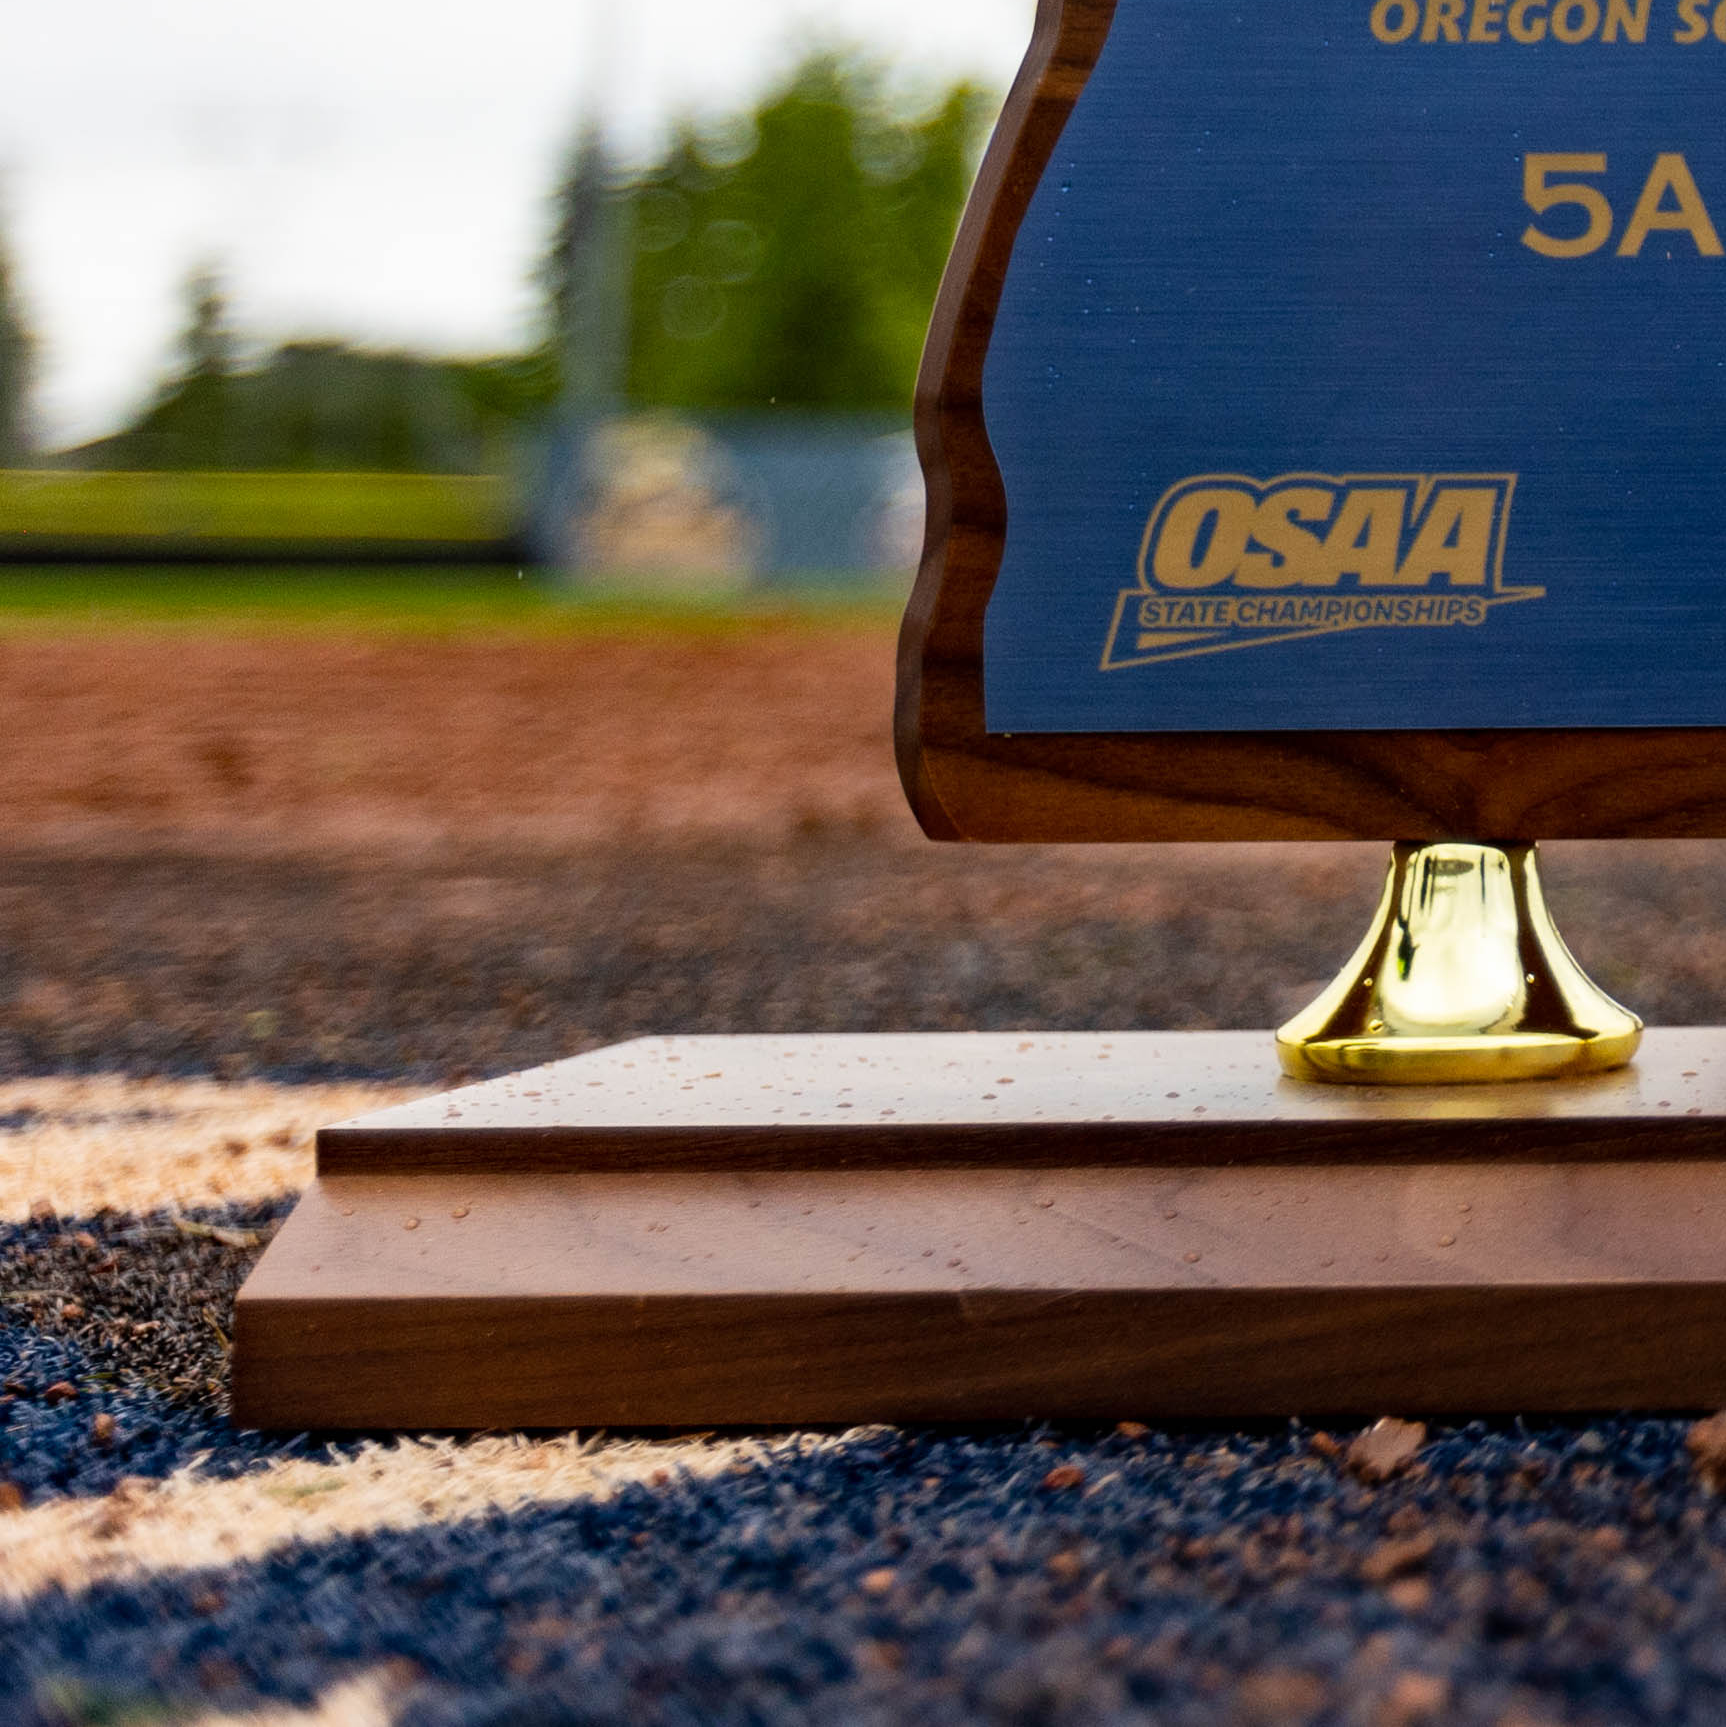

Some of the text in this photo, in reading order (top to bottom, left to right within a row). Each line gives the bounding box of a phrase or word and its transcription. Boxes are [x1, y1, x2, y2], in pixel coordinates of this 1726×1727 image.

[1520, 152, 1726, 259] 5A
[1150, 485, 1500, 590] OSAA
[1142, 596, 1484, 624] STATE CHAMPIONSHIPS
